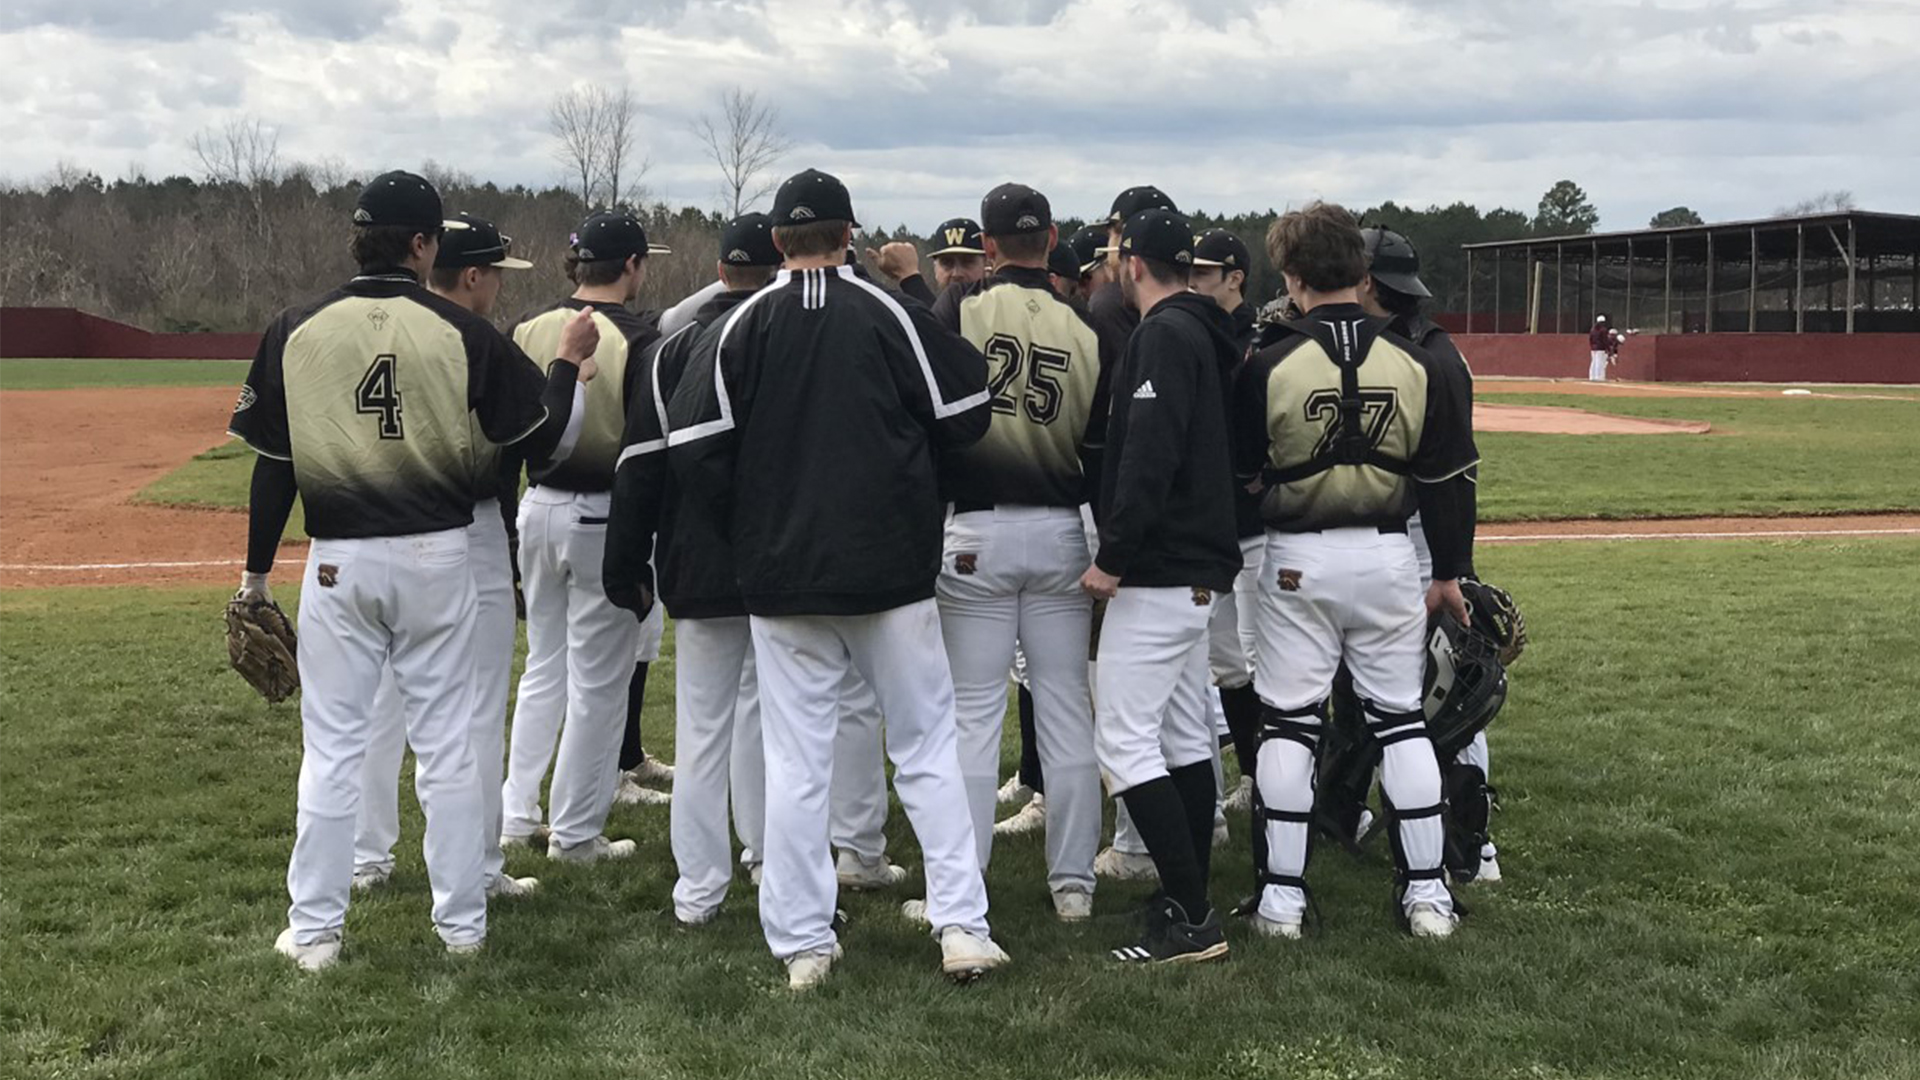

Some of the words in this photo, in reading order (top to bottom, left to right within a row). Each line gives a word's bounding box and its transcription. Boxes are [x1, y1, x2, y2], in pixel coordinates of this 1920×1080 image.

[944, 227, 966, 245] W
[355, 353, 404, 440] 4
[984, 332, 1071, 427] 25
[1303, 386, 1398, 460] 27
